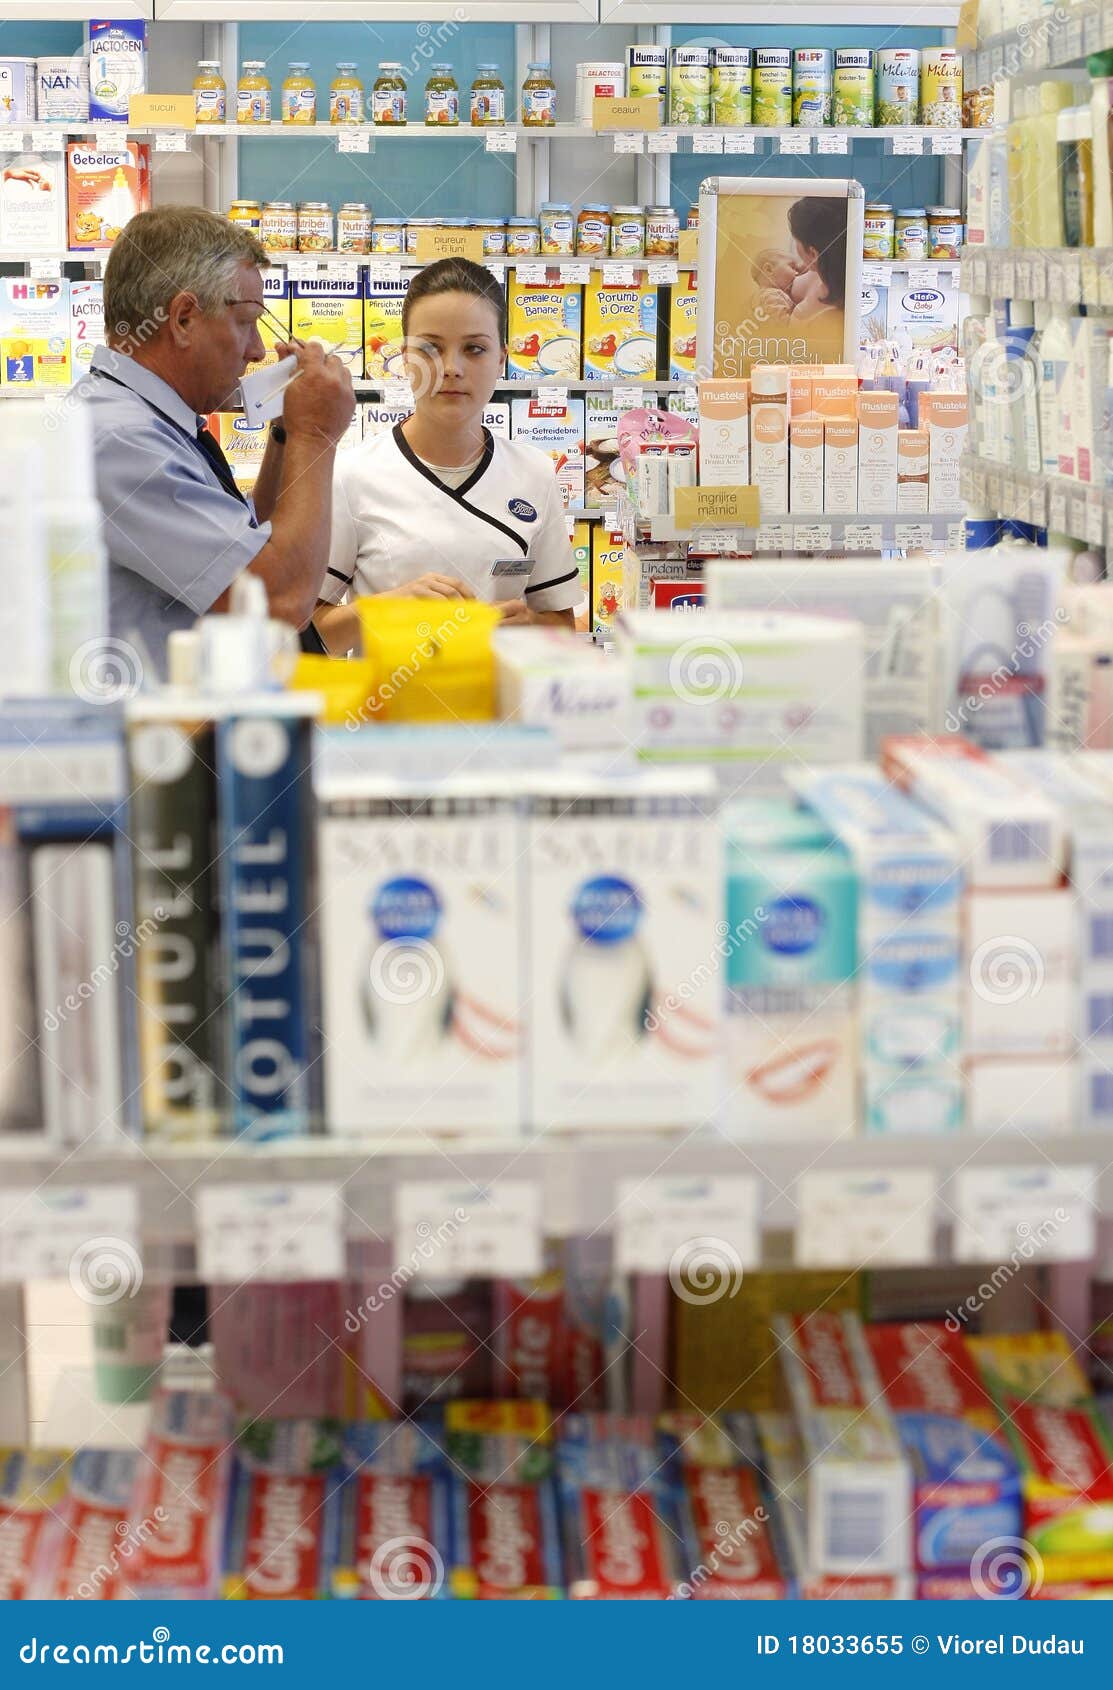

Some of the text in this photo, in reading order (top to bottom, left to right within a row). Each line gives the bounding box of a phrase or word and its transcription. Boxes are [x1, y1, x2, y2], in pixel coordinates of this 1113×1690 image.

[92, 40, 142, 54] LACTOGEN
[636, 52, 665, 62] Humana
[677, 52, 709, 63] Humana
[717, 53, 748, 63] Humana
[758, 54, 788, 64] Humana
[797, 52, 823, 62] HiPP
[837, 54, 868, 64] Humana
[97, 57, 107, 78] 1
[41, 75, 79, 89] NAN
[149, 103, 176, 112] sucuri
[611, 105, 641, 114] ceaiuri
[73, 153, 121, 165] Bebelac
[864, 221, 886, 229] HiPP
[434, 236, 466, 245] piureuri
[13, 284, 59, 299] HiPP
[515, 294, 562, 306] Cereale cu
[597, 292, 639, 303] Porumb
[72, 303, 105, 317] LACTO
[311, 301, 345, 309] Bananen-
[610, 304, 635, 315] Orez
[524, 305, 558, 317] Banane
[77, 320, 87, 339] 2
[720, 337, 807, 358] mama
[18, 361, 26, 374] 2
[702, 391, 746, 401] mustela
[861, 400, 897, 411] mustela
[931, 400, 967, 410] mustela
[368, 409, 413, 424] Noval
[532, 407, 563, 416] milupa
[589, 415, 618, 423] crema
[517, 427, 579, 436] Bio-Getreidebrei
[600, 554, 607, 565] 7
[641, 562, 684, 574] Lindam
